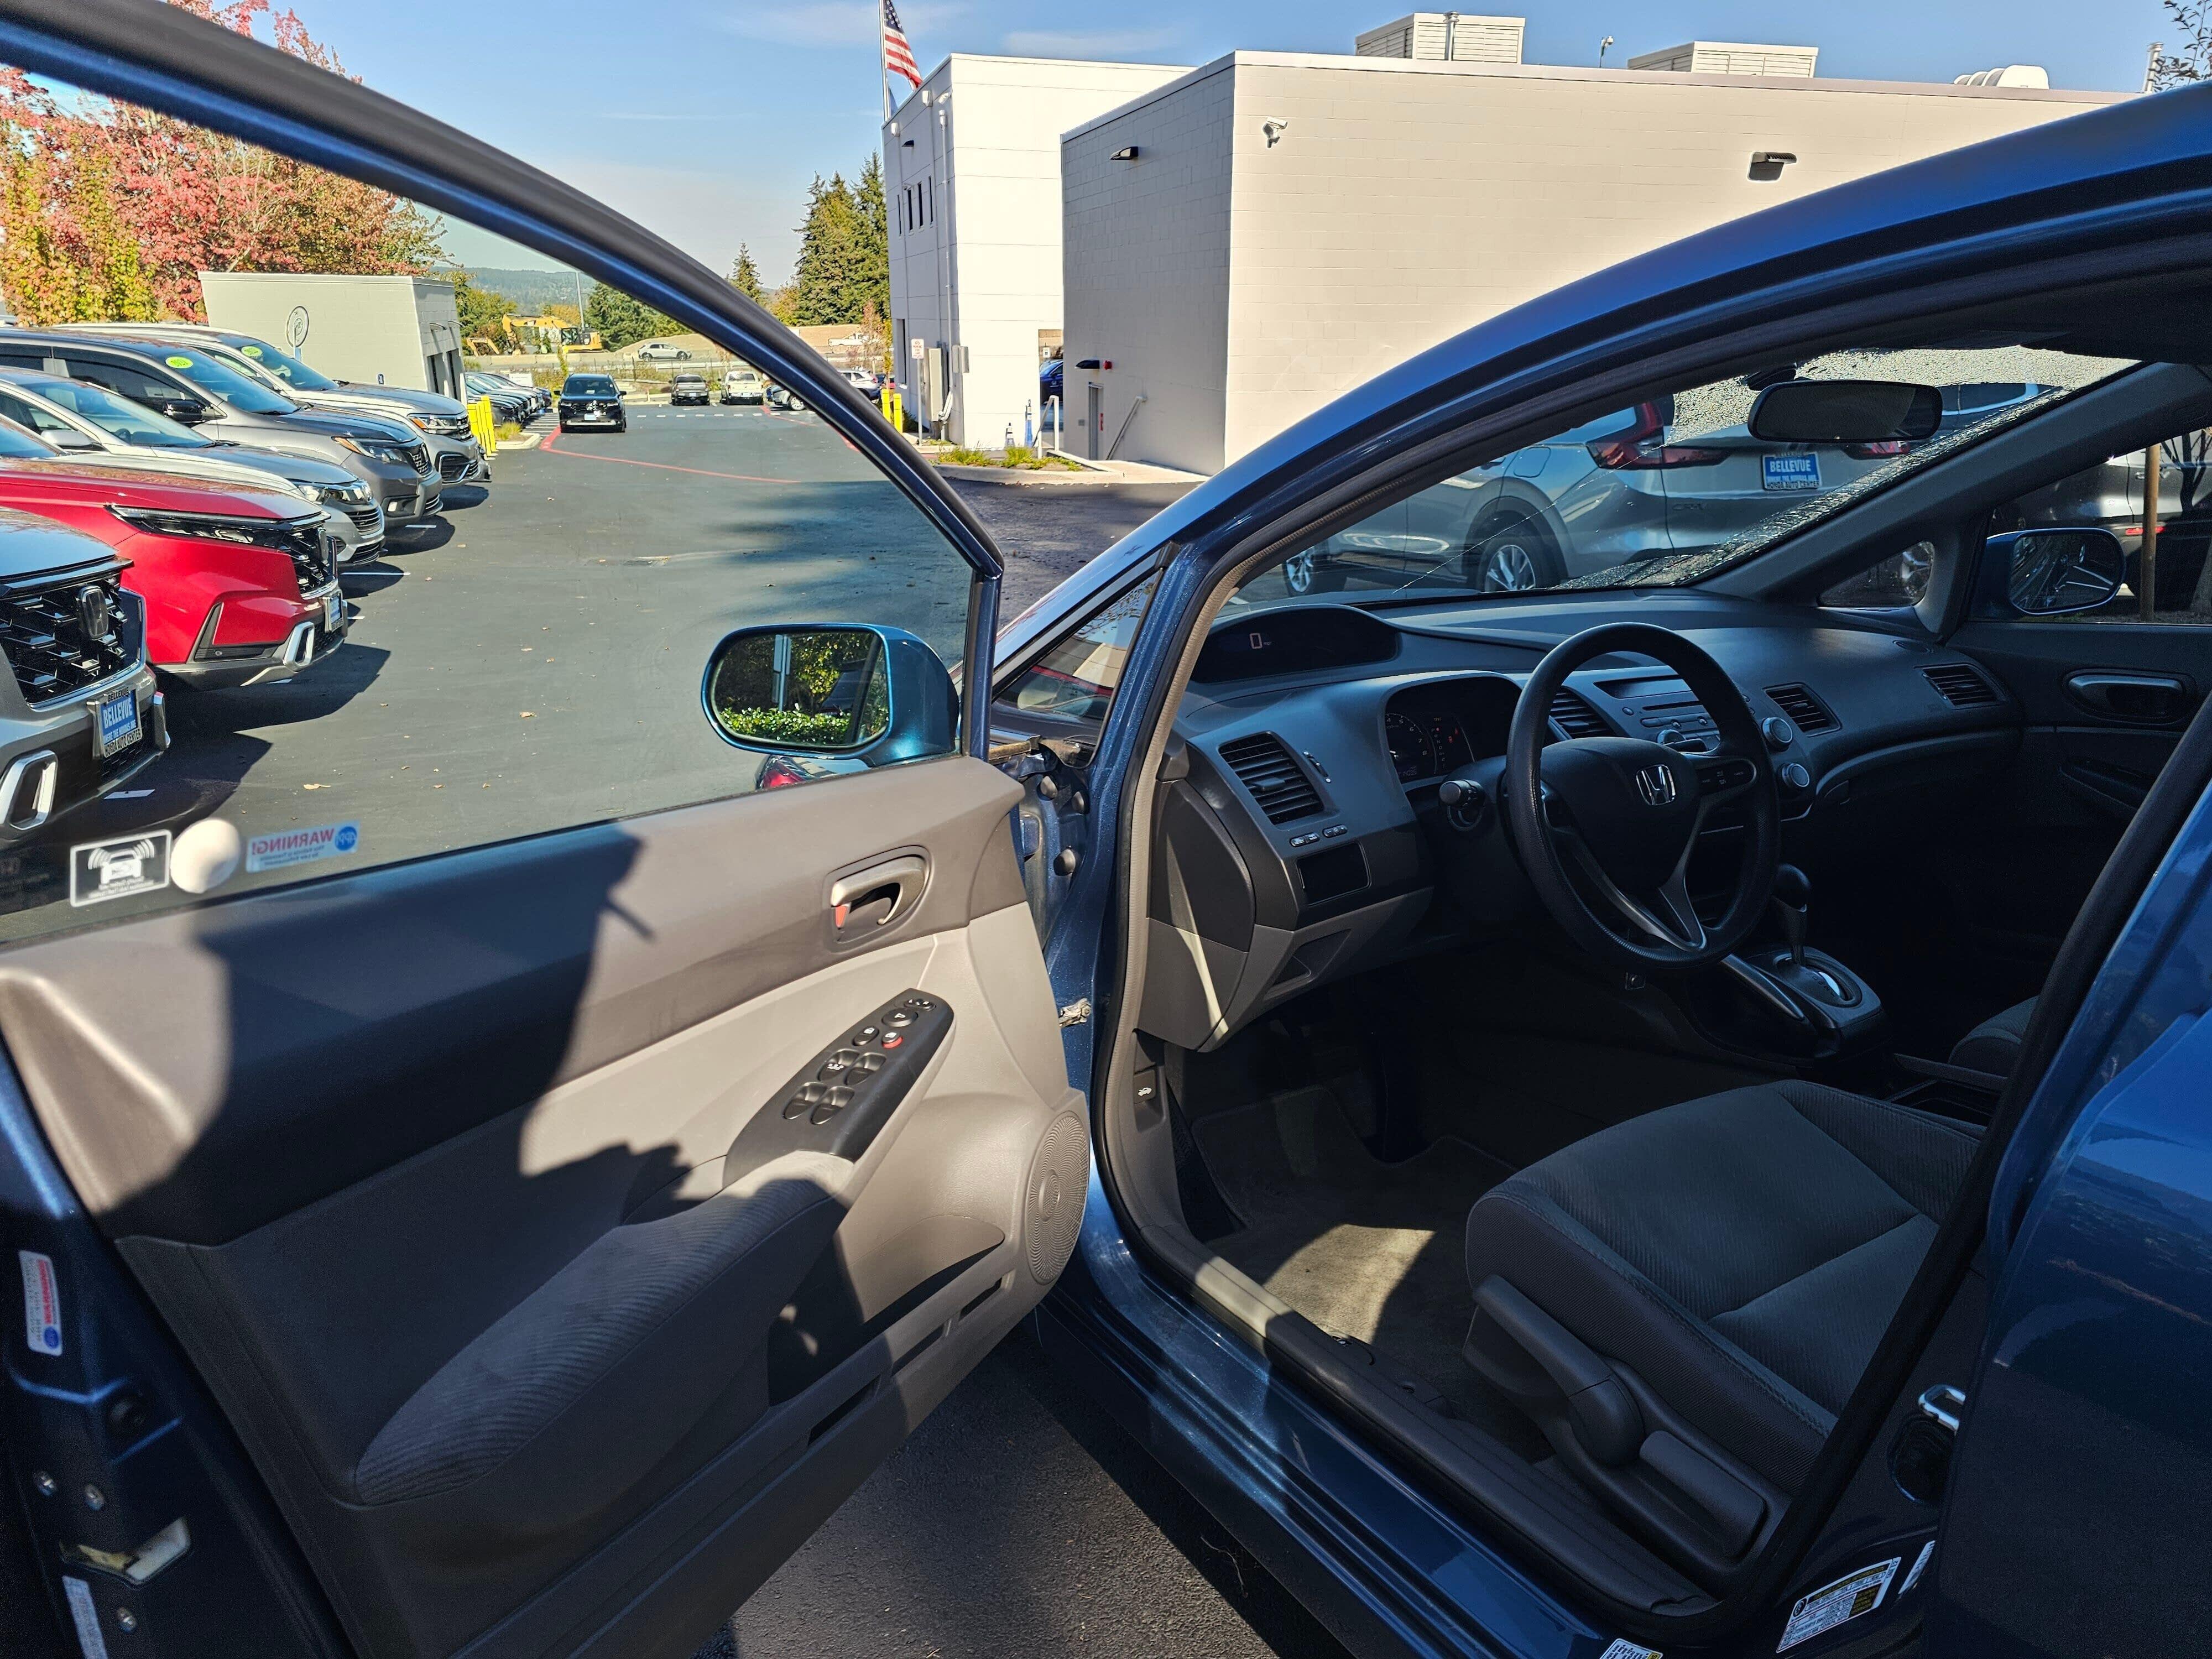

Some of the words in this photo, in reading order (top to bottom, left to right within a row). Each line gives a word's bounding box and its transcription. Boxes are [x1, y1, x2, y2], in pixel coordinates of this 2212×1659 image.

[1770, 460, 1811, 472] BELLEVUE
[108, 687, 129, 701] BELLEVUE
[103, 697, 133, 729] BELLEVUE
